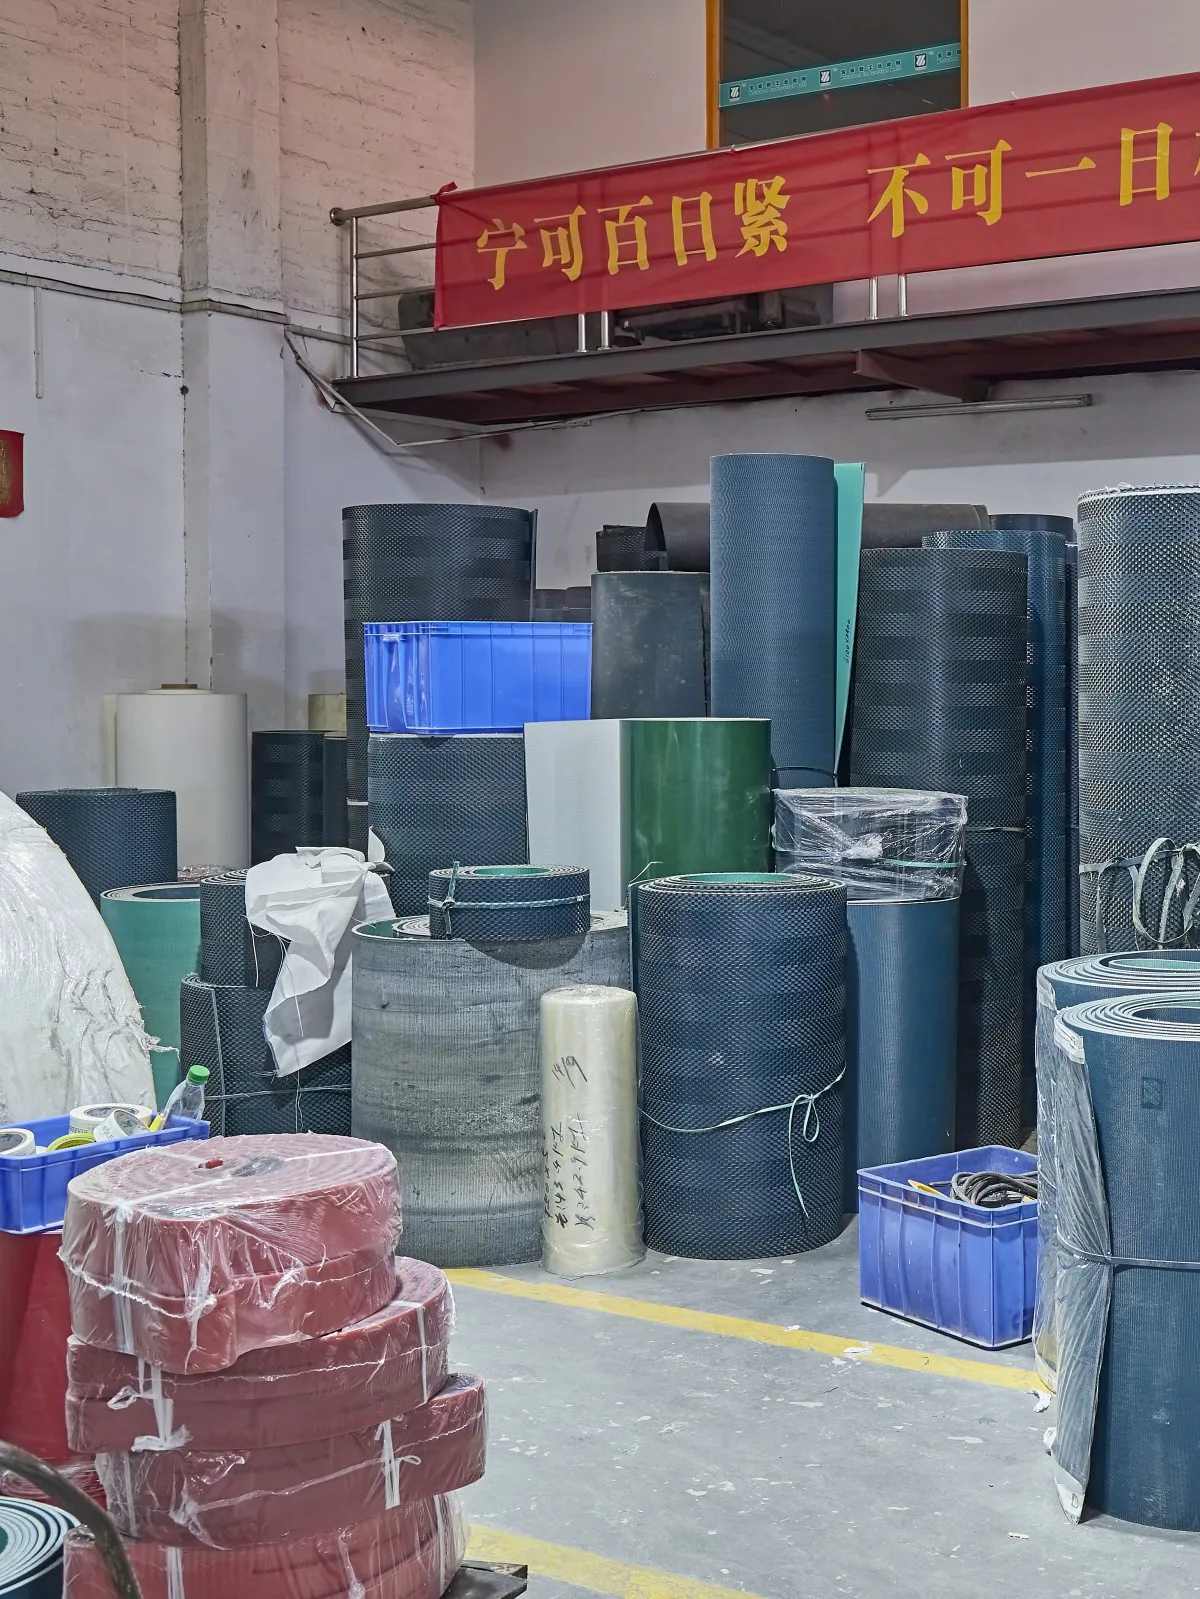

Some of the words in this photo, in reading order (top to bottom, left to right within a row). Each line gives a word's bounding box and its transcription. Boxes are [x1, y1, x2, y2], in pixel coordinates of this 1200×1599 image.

[476, 175, 789, 291] 宁可百日紧
